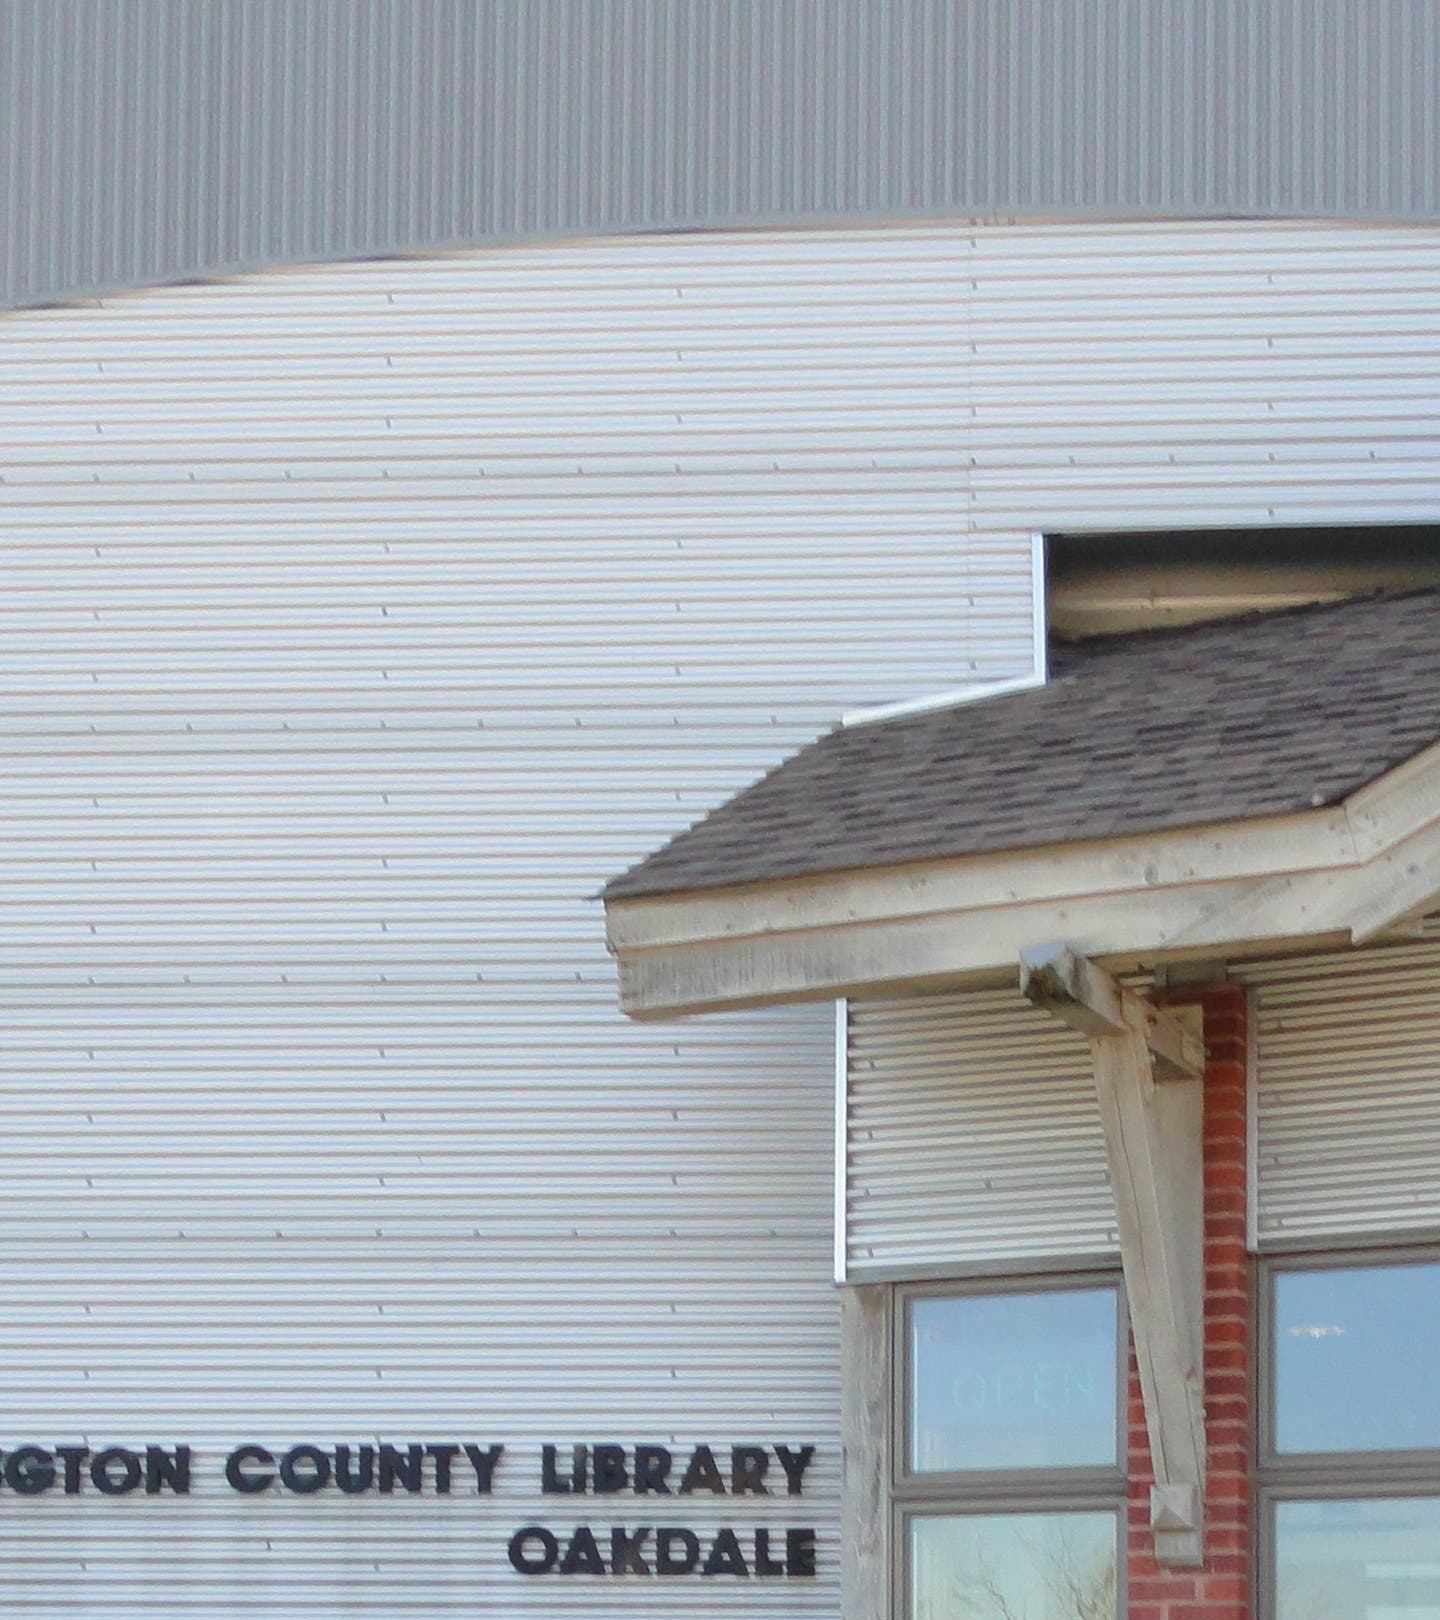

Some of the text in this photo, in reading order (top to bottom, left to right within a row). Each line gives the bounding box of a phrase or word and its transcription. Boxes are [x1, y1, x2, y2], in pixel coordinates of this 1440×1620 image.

[225, 1443, 503, 1495] COUNTY
[541, 1444, 815, 1496] LIBRARY
[508, 1525, 816, 1577] OAKDALE
